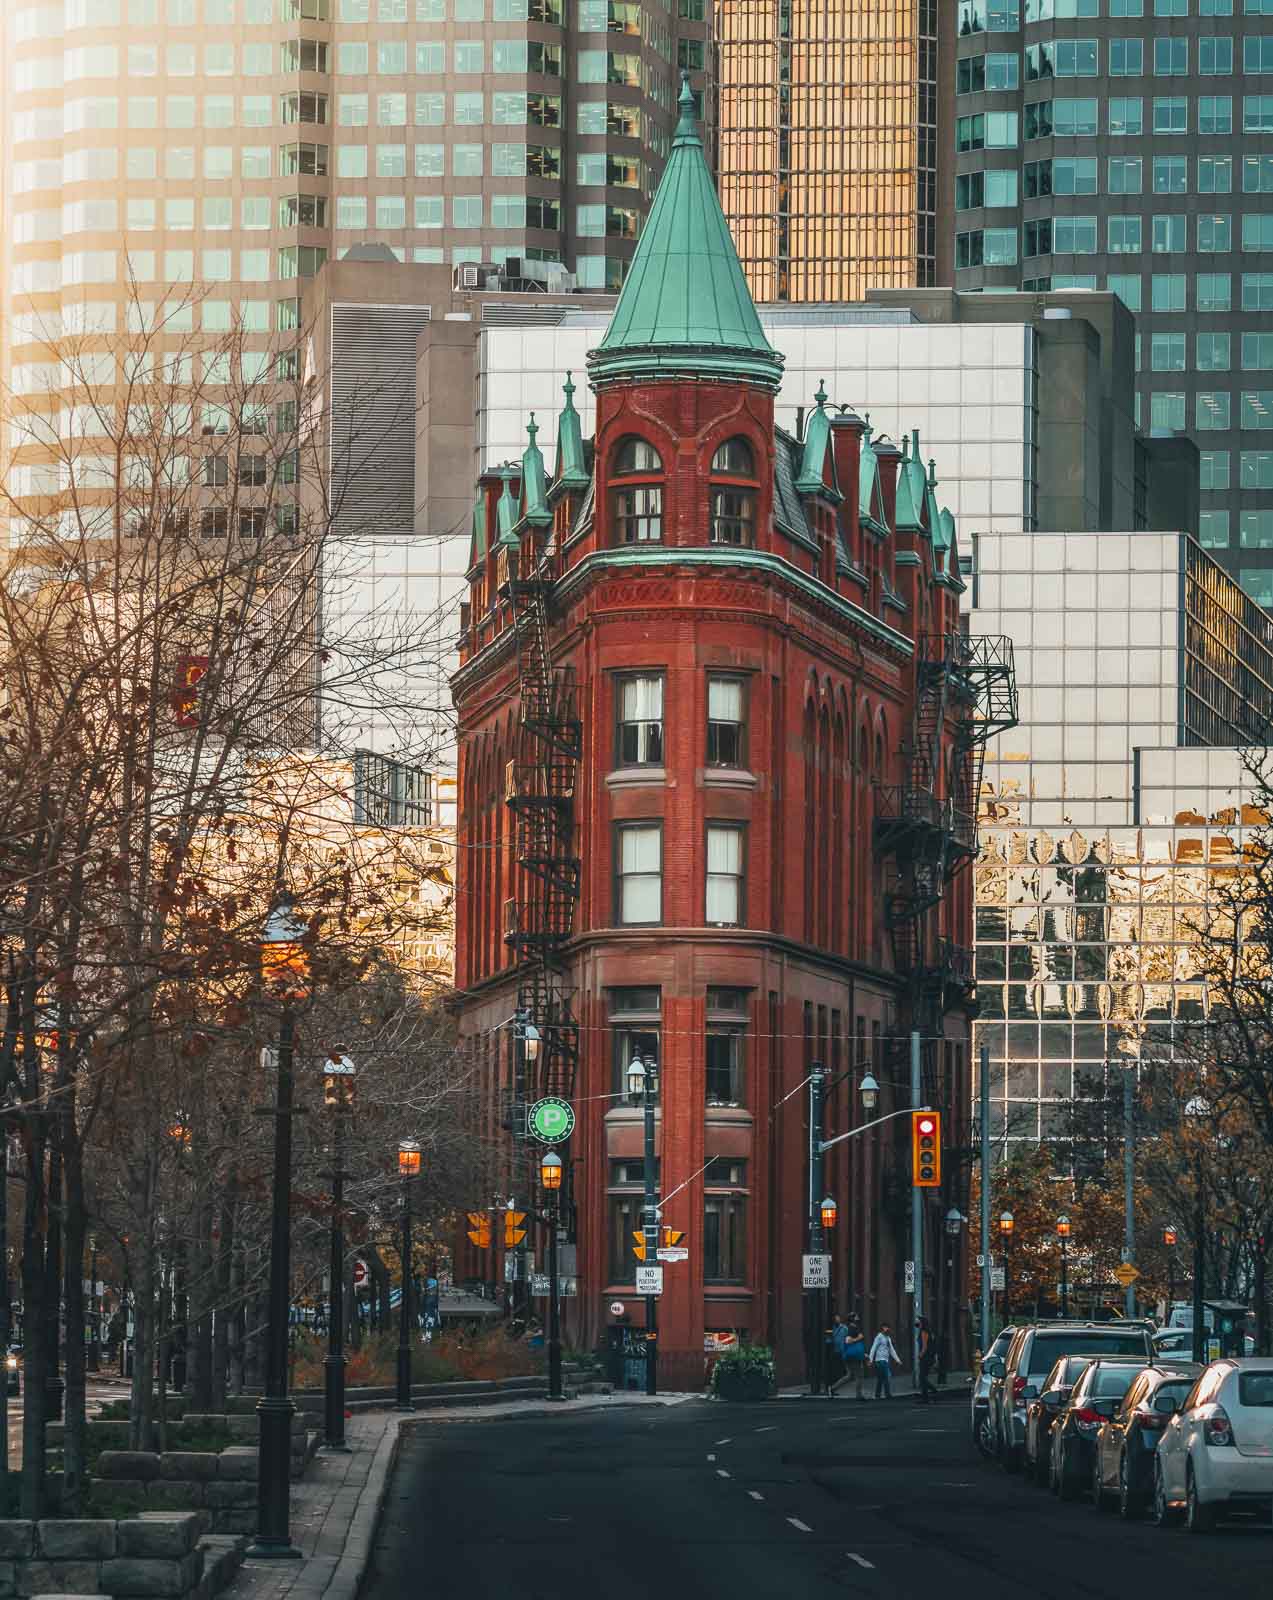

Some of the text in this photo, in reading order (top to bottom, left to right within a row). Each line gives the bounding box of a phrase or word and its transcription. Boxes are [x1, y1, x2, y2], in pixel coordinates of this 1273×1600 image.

[544, 1109, 560, 1127] P
[809, 1257, 822, 1265] ONE
[645, 1269, 654, 1277] NO
[809, 1267, 822, 1275] WAY
[804, 1276, 827, 1285] BEGINS
